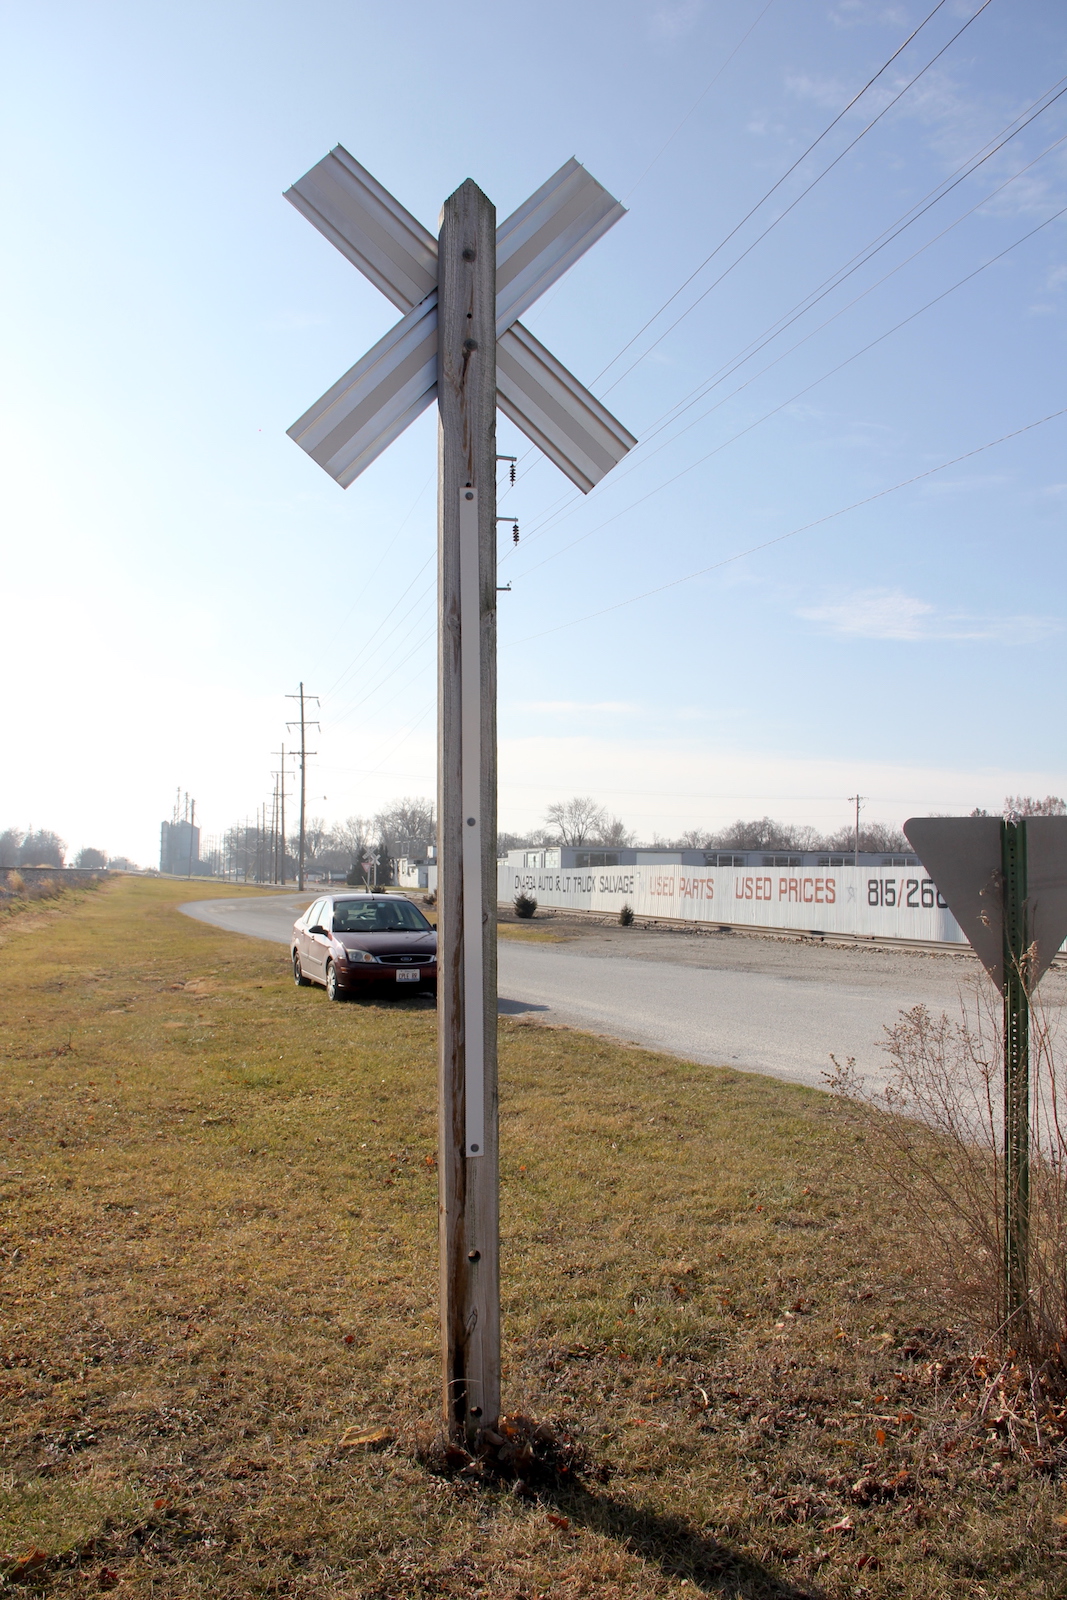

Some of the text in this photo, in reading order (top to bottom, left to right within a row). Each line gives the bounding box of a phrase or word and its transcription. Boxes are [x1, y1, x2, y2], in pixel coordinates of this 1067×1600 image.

[514, 875, 536, 890] ONARGA
[538, 875, 554, 891] AUTO
[556, 875, 561, 891] &
[573, 876, 597, 893] TRUCK
[599, 875, 634, 894] SALVAGE
[650, 876, 714, 900] USED PARTS
[735, 876, 836, 904] USED PRICES
